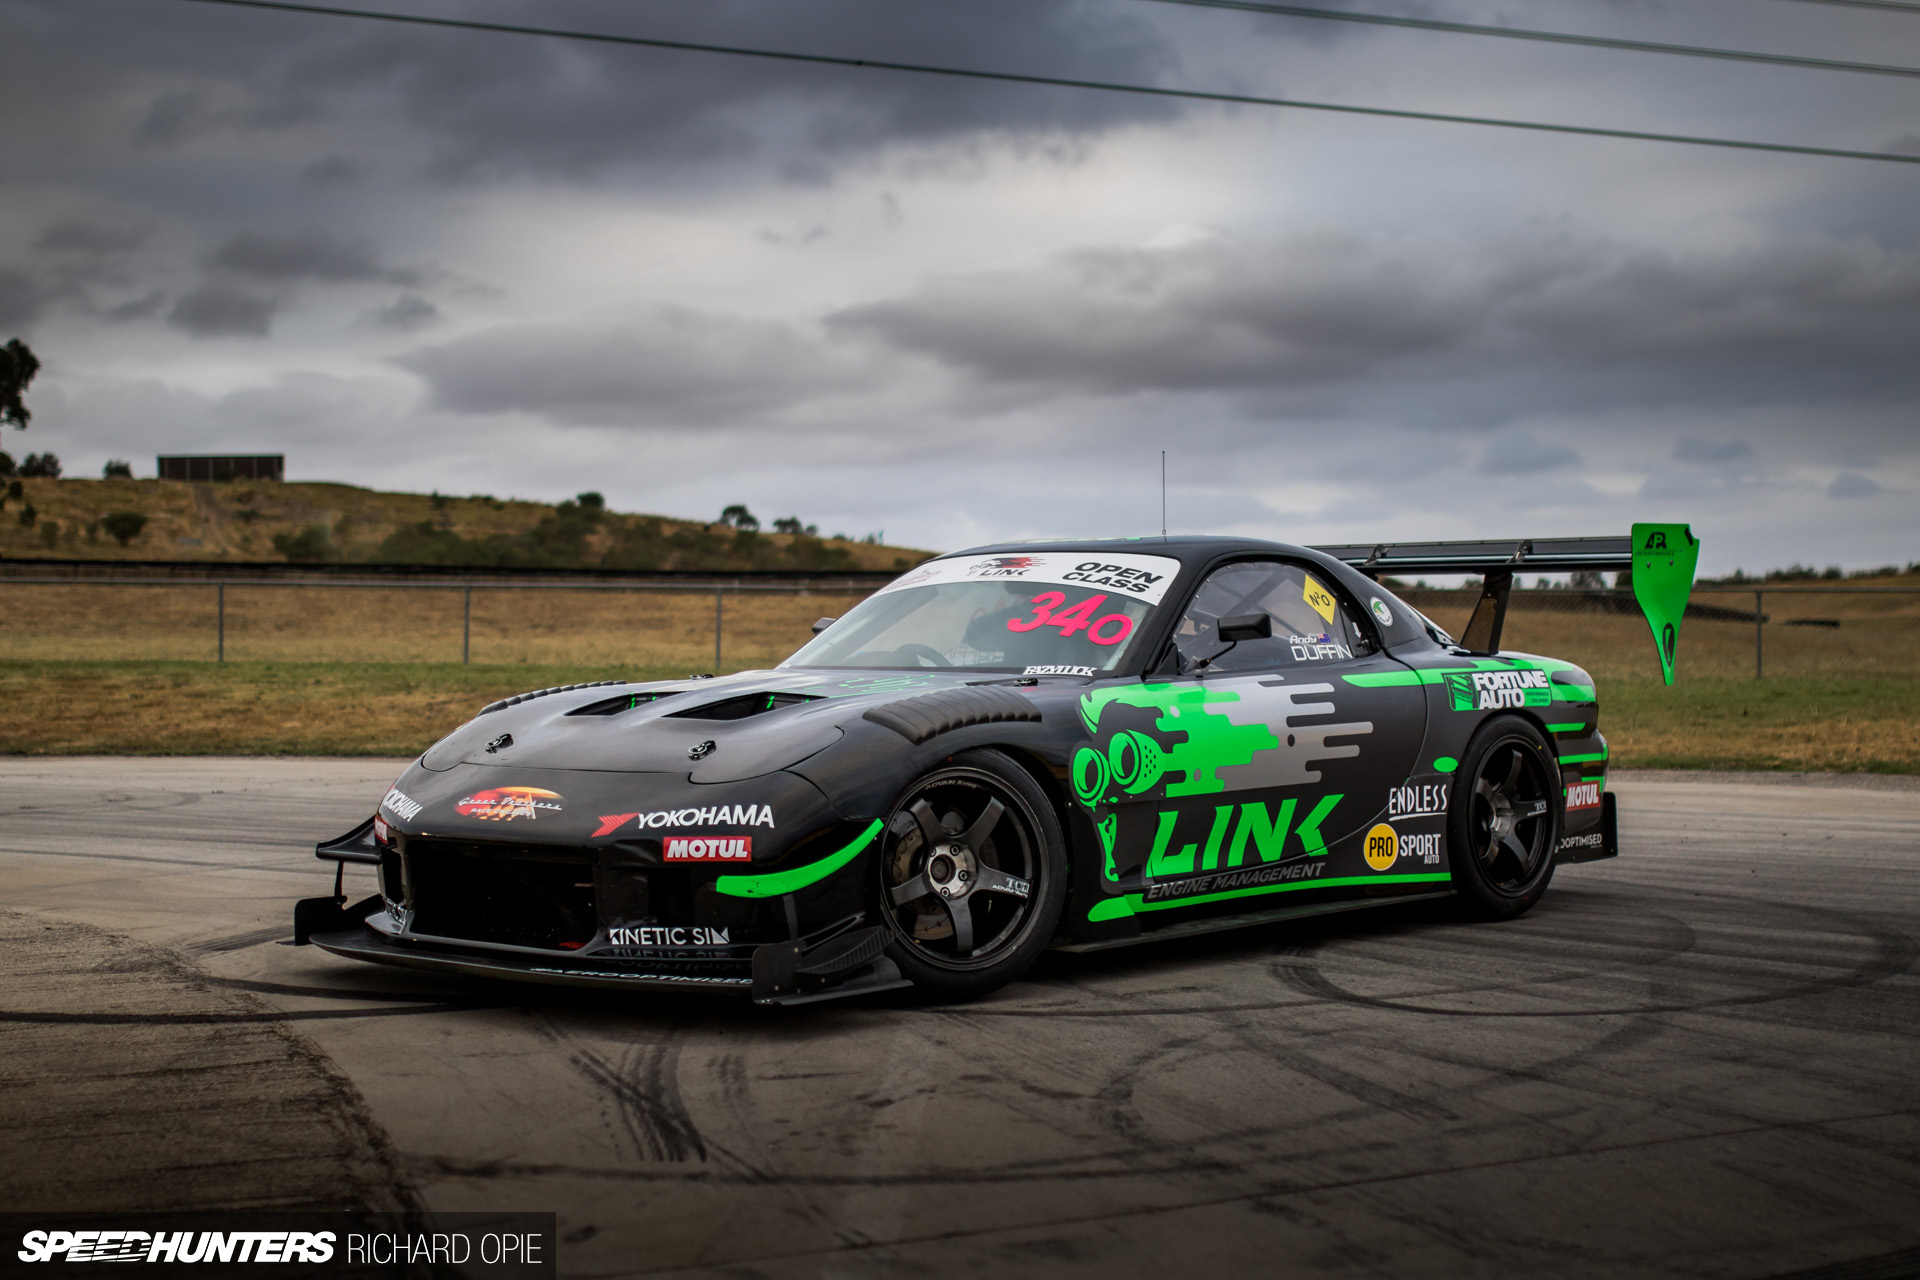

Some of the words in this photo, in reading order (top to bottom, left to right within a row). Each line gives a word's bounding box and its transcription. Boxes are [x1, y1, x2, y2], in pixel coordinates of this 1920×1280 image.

[1062, 572, 1151, 594] CLASS
[1074, 561, 1164, 584] OPEN
[1290, 635, 1317, 644] Andy
[1291, 645, 1353, 662] DUFFIN
[1472, 671, 1550, 691] FORTUNE
[1479, 688, 1525, 710] AUTO
[1388, 784, 1448, 814] ENDLESS
[1566, 784, 1599, 807] MOTUL
[638, 804, 775, 829] YOKOHAMA
[1146, 793, 1345, 877] LINK
[1368, 836, 1393, 857] PRO
[1400, 833, 1441, 856] SPORT
[667, 839, 748, 858] MOTUL
[1424, 854, 1440, 864] AUTO
[1147, 878, 1210, 899] ENGINE
[1212, 862, 1326, 889] MANAGEMENT
[609, 928, 687, 945] KINETIC
[693, 927, 730, 944] SIM
